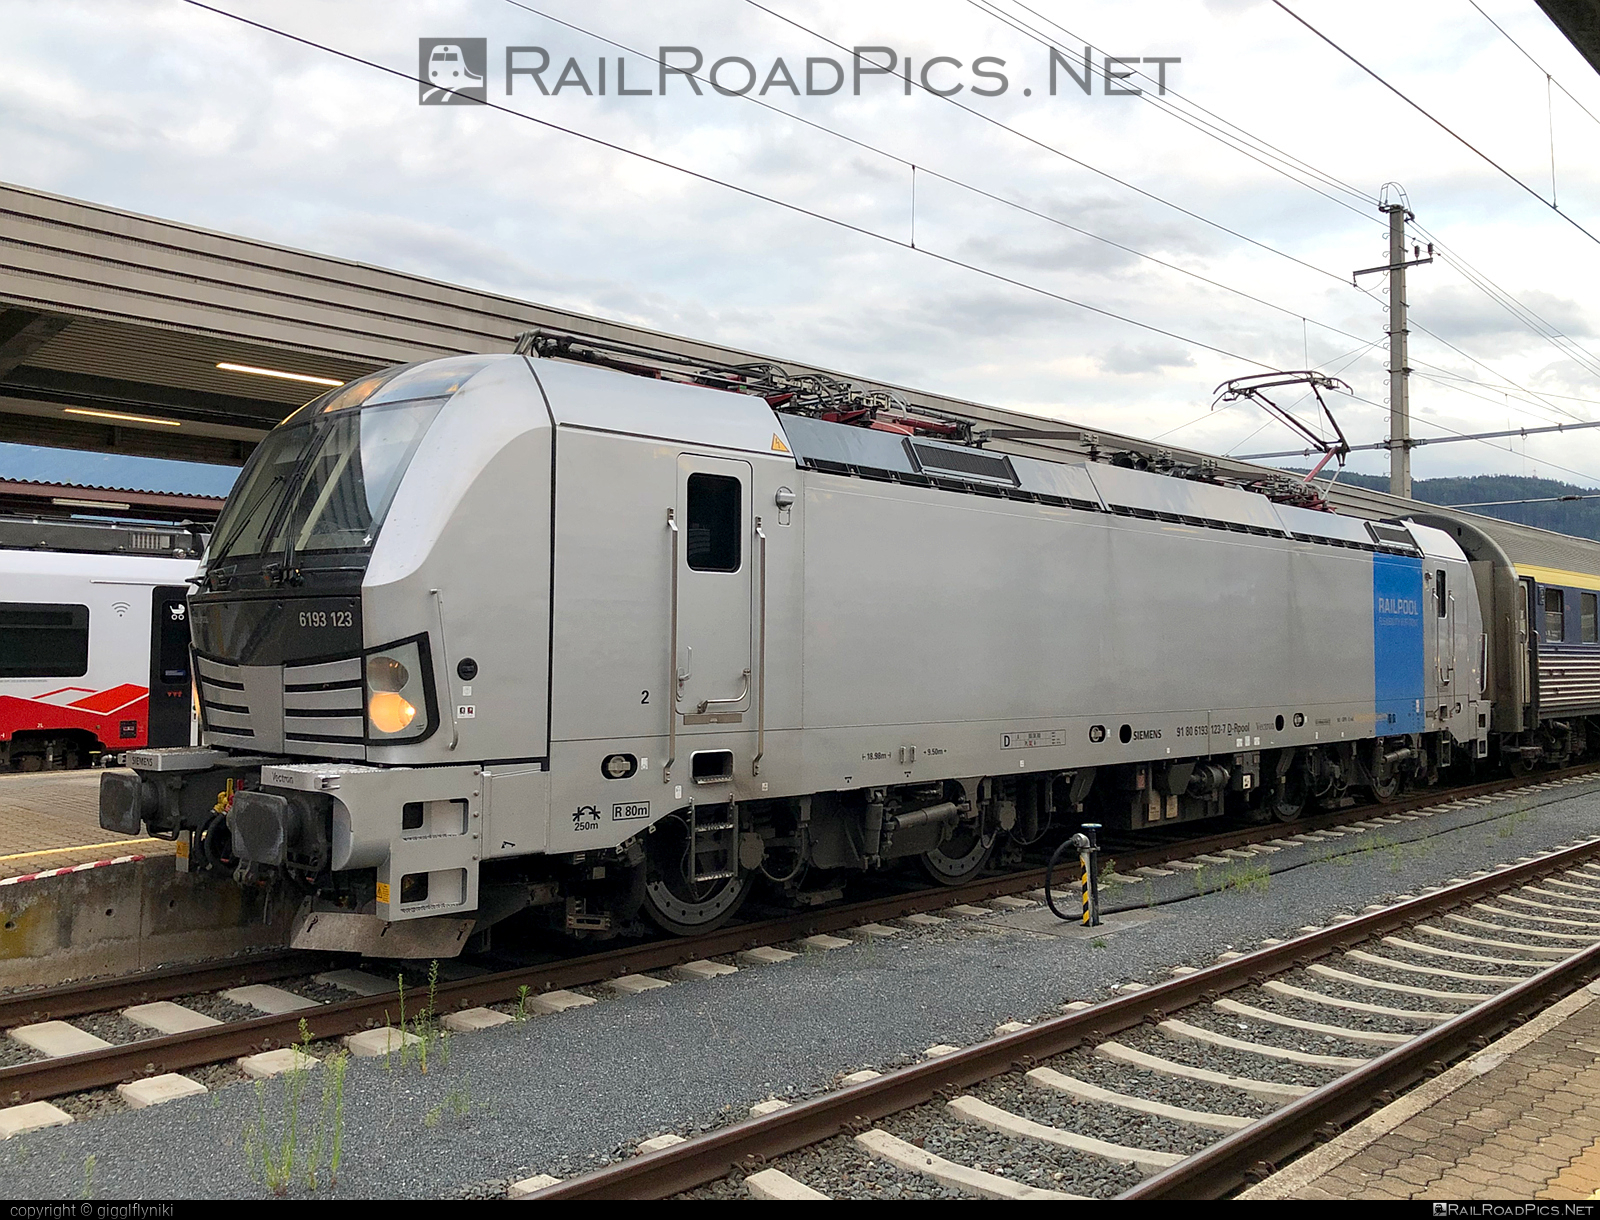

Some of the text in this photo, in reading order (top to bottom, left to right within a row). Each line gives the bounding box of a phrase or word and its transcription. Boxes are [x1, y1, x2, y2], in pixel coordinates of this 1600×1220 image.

[1378, 597, 1419, 616] RAILPOOL
[299, 611, 353, 627] 6193 123
[640, 690, 650, 704] 2
[1133, 729, 1162, 740] SIEMENS
[1176, 726, 1184, 737] 91
[1185, 726, 1193, 736] 80
[1194, 725, 1208, 736] 6193
[1211, 723, 1226, 734] 123-7
[1003, 735, 1011, 747] D
[131, 755, 153, 767] SIEMENS
[272, 771, 294, 784] Vectron
[614, 805, 648, 817] R 80m
[574, 822, 599, 831] 250m
